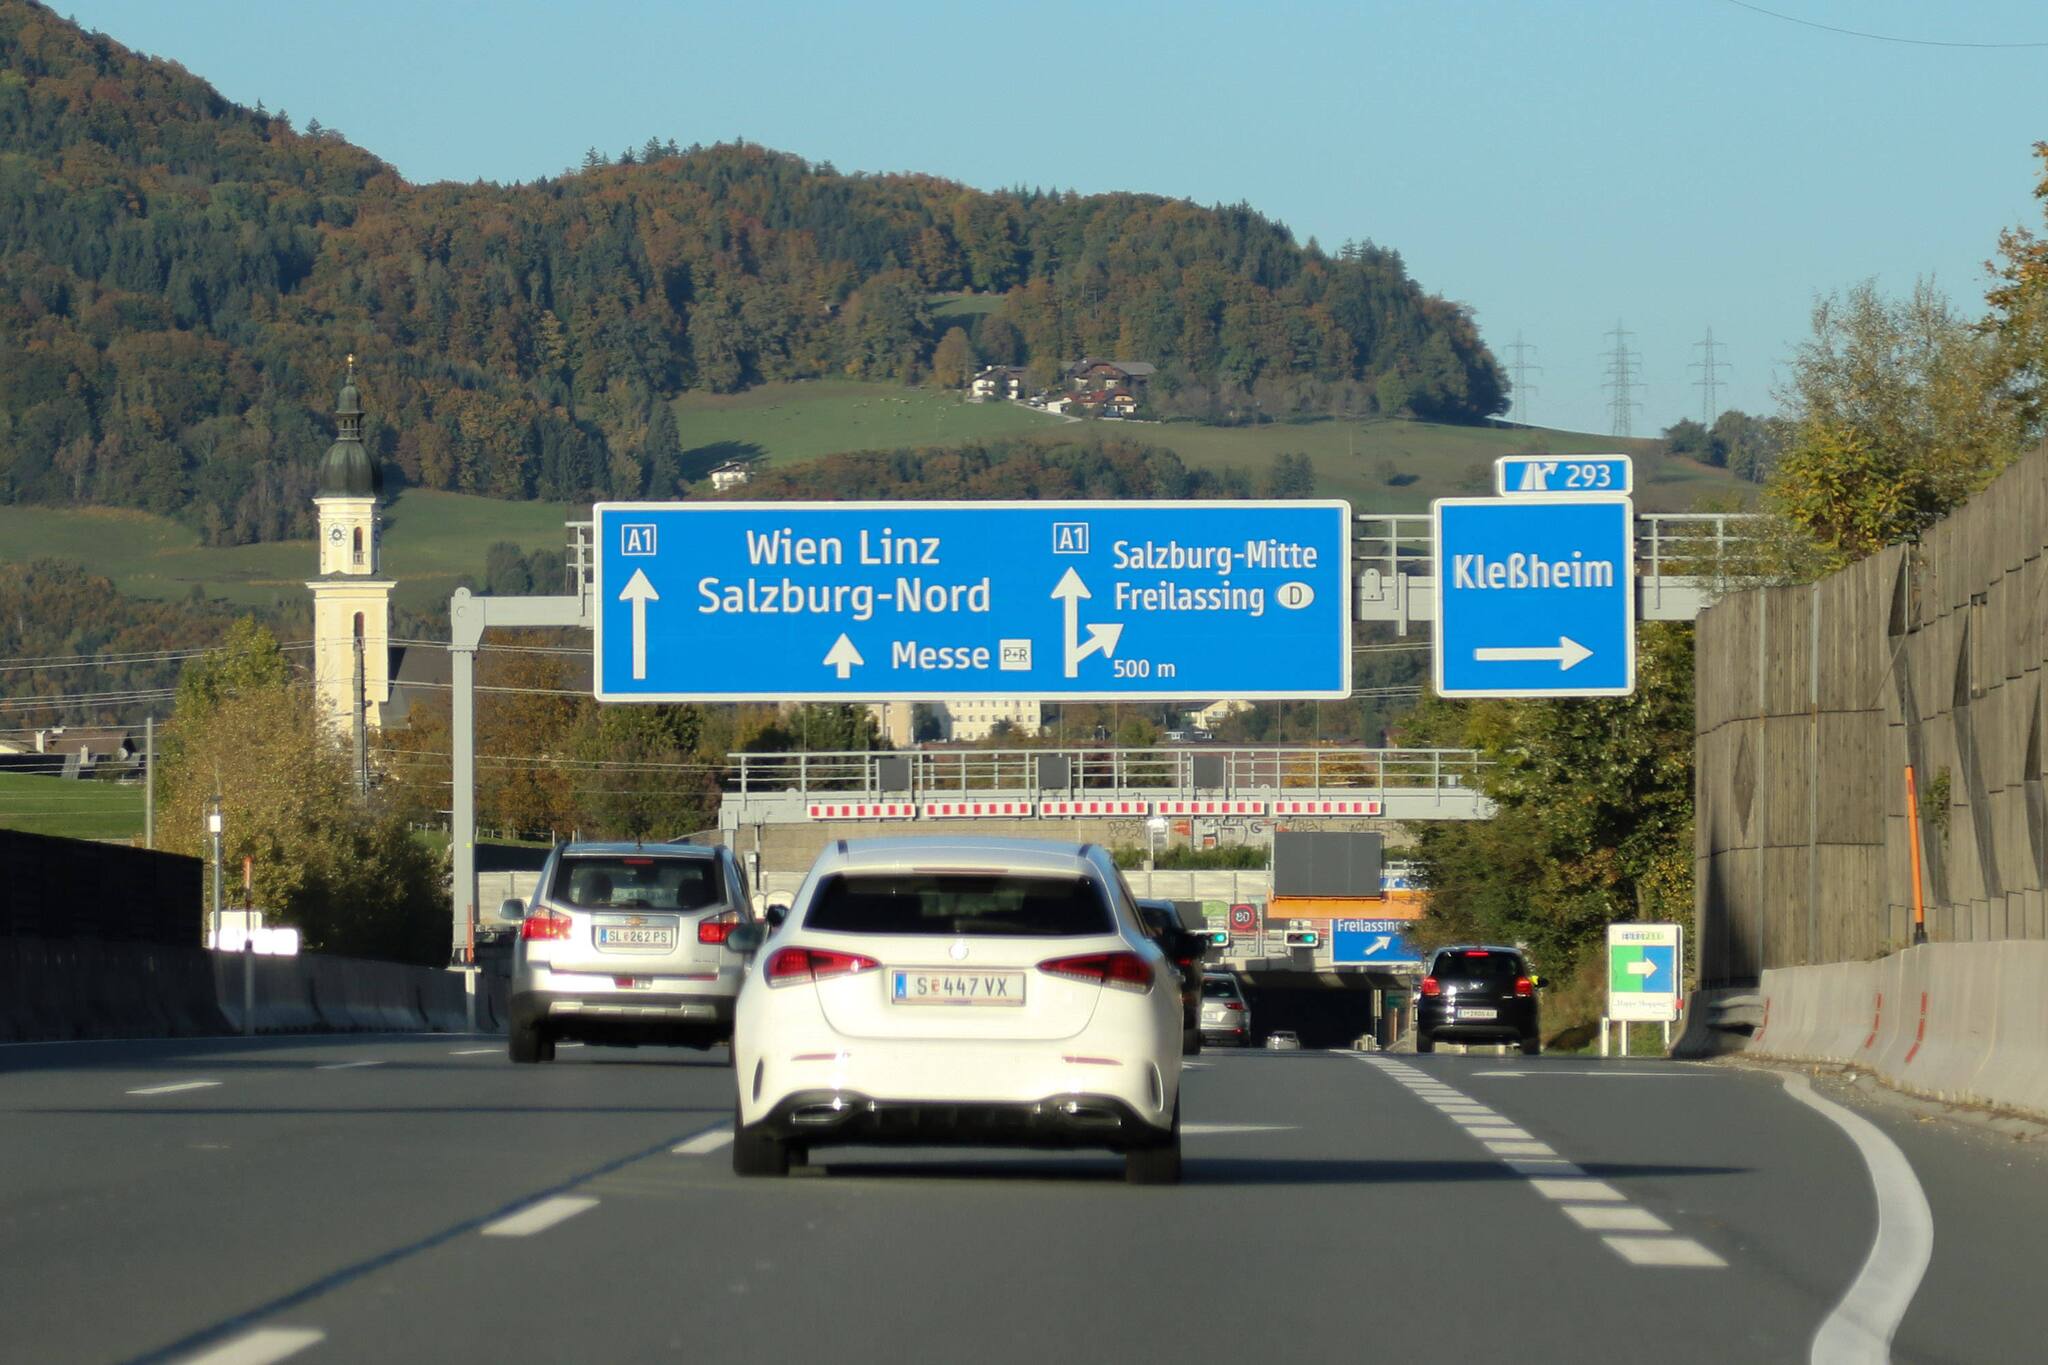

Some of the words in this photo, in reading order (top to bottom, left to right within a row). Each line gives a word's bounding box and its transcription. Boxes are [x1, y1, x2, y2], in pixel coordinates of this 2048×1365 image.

[1565, 464, 1611, 488] 293
[627, 528, 651, 552] A1
[746, 527, 842, 565] Wien
[860, 527, 940, 565] Linz
[1058, 527, 1084, 550] A1
[1113, 539, 1318, 576] Salzburg-Mitte
[1454, 551, 1613, 589] Kleßheim
[698, 577, 990, 621] Salzburg-Nord
[1115, 580, 1265, 617] Freilassing
[892, 641, 990, 670] Messe
[1003, 647, 1028, 663] P+R
[1113, 659, 1150, 678] 500
[1157, 663, 1176, 678] m
[1235, 911, 1250, 922] 80
[609, 931, 622, 942] SL
[917, 977, 928, 995] S
[943, 977, 979, 996] 447
[984, 978, 1008, 996] VX
